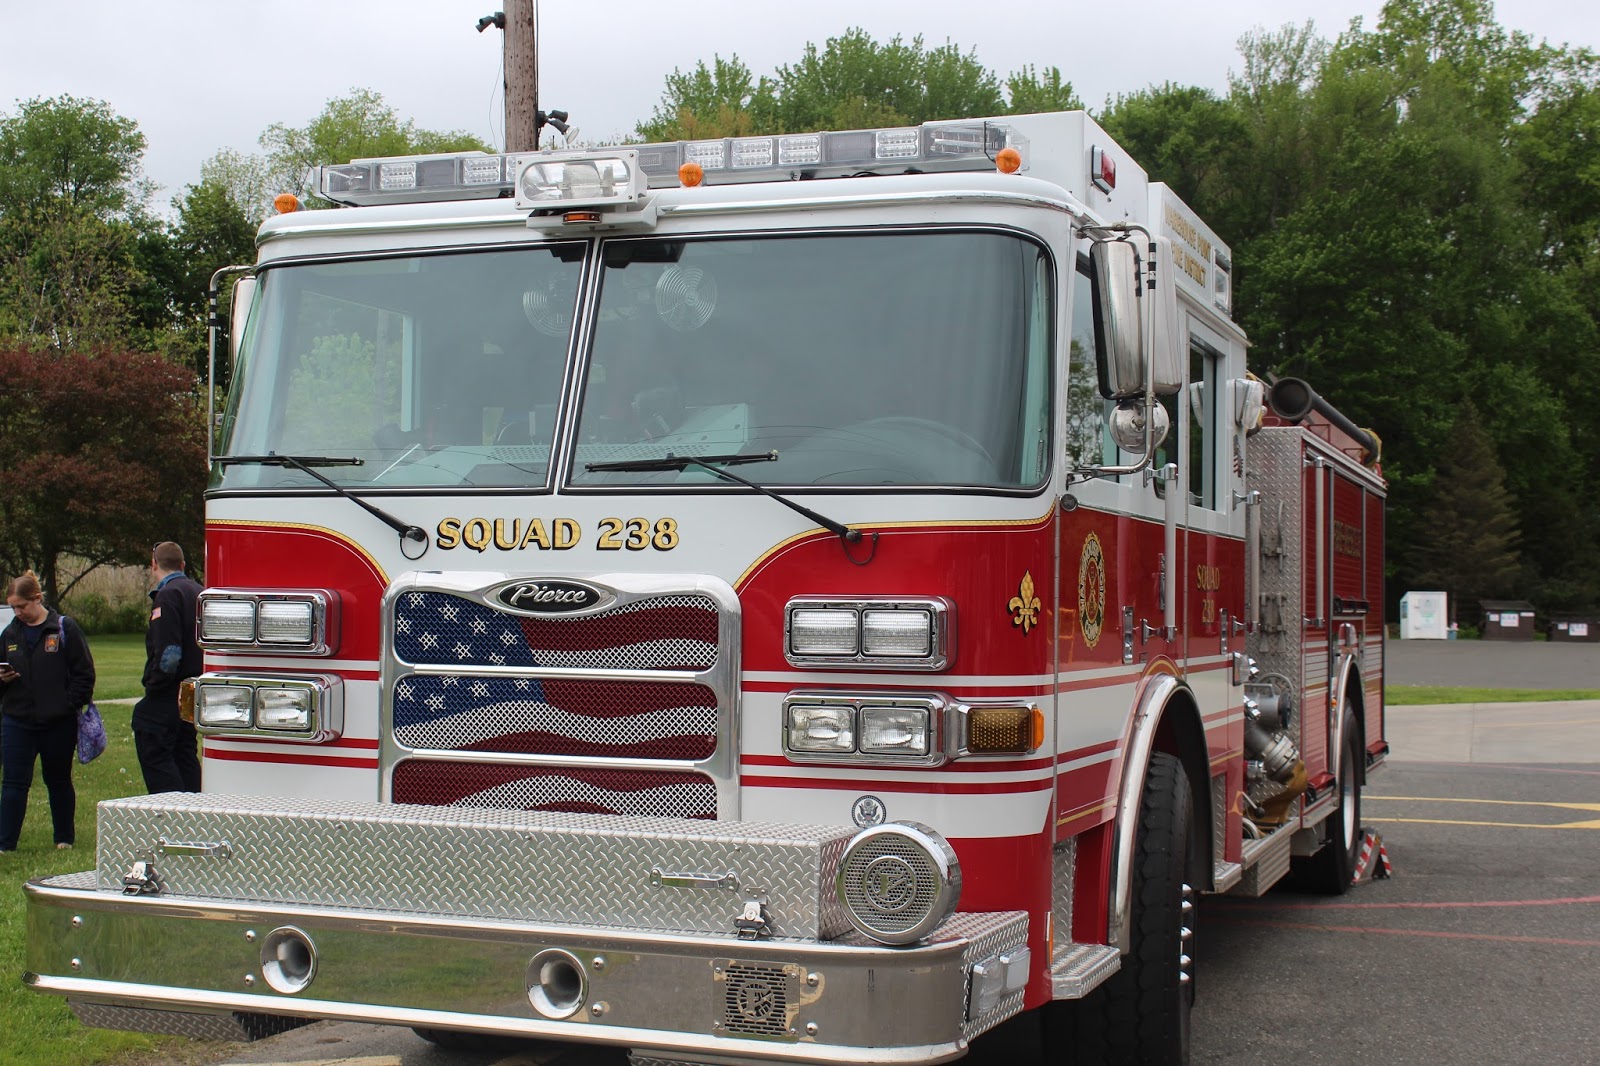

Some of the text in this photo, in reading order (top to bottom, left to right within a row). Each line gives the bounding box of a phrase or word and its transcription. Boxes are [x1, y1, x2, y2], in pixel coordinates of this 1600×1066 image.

[436, 517, 680, 553] SQUAD 238
[1197, 564, 1220, 591] SQUAD
[509, 583, 588, 606] Pierce
[1202, 598, 1215, 623] 238
